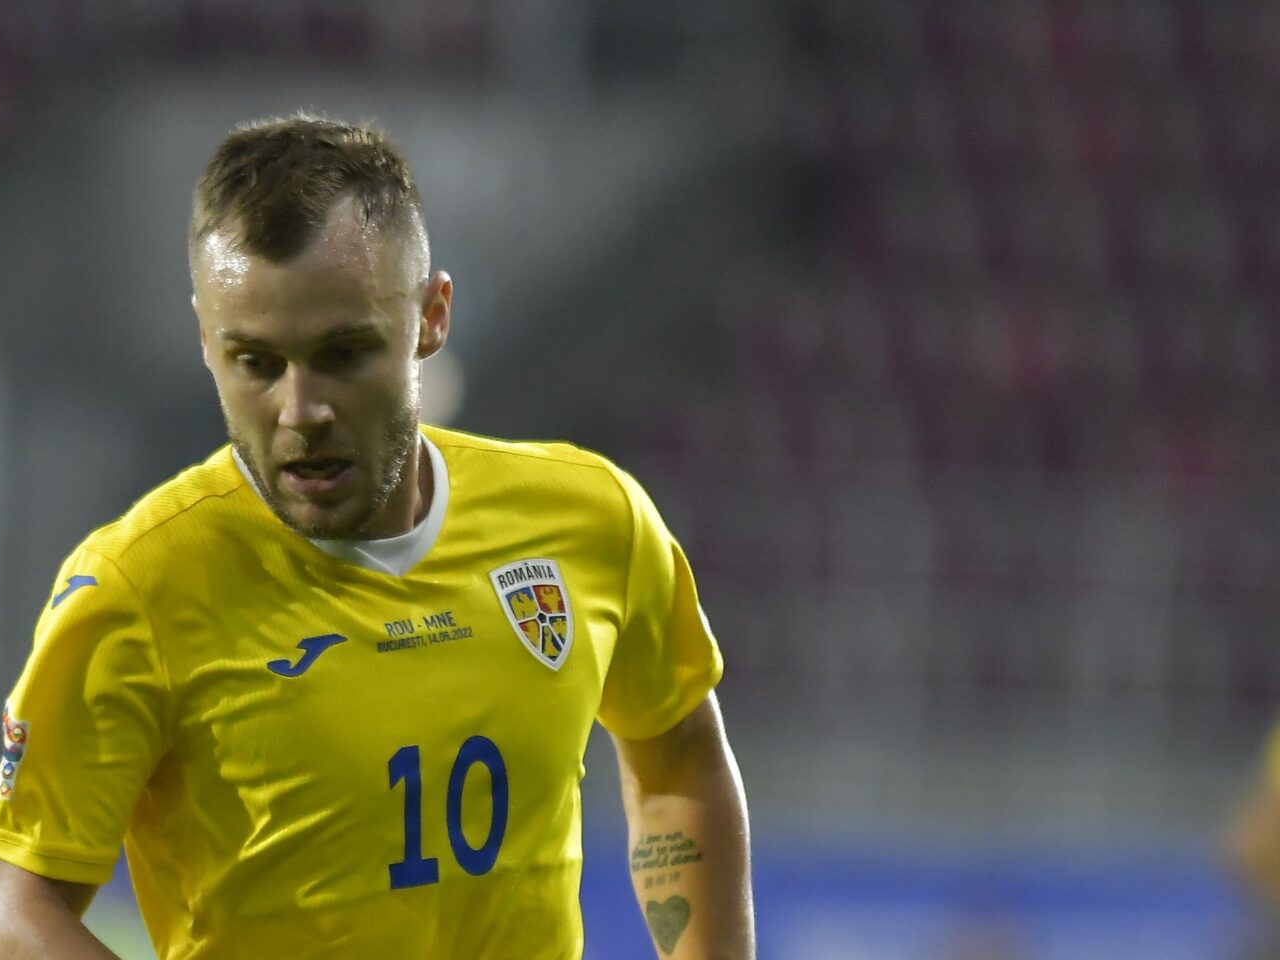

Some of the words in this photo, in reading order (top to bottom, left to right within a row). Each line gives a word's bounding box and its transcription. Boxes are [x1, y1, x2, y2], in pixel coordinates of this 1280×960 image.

[497, 562, 556, 589] ROMÂNIA
[384, 618, 415, 638] ROU
[423, 611, 457, 631] MNE
[387, 734, 510, 890] 10
